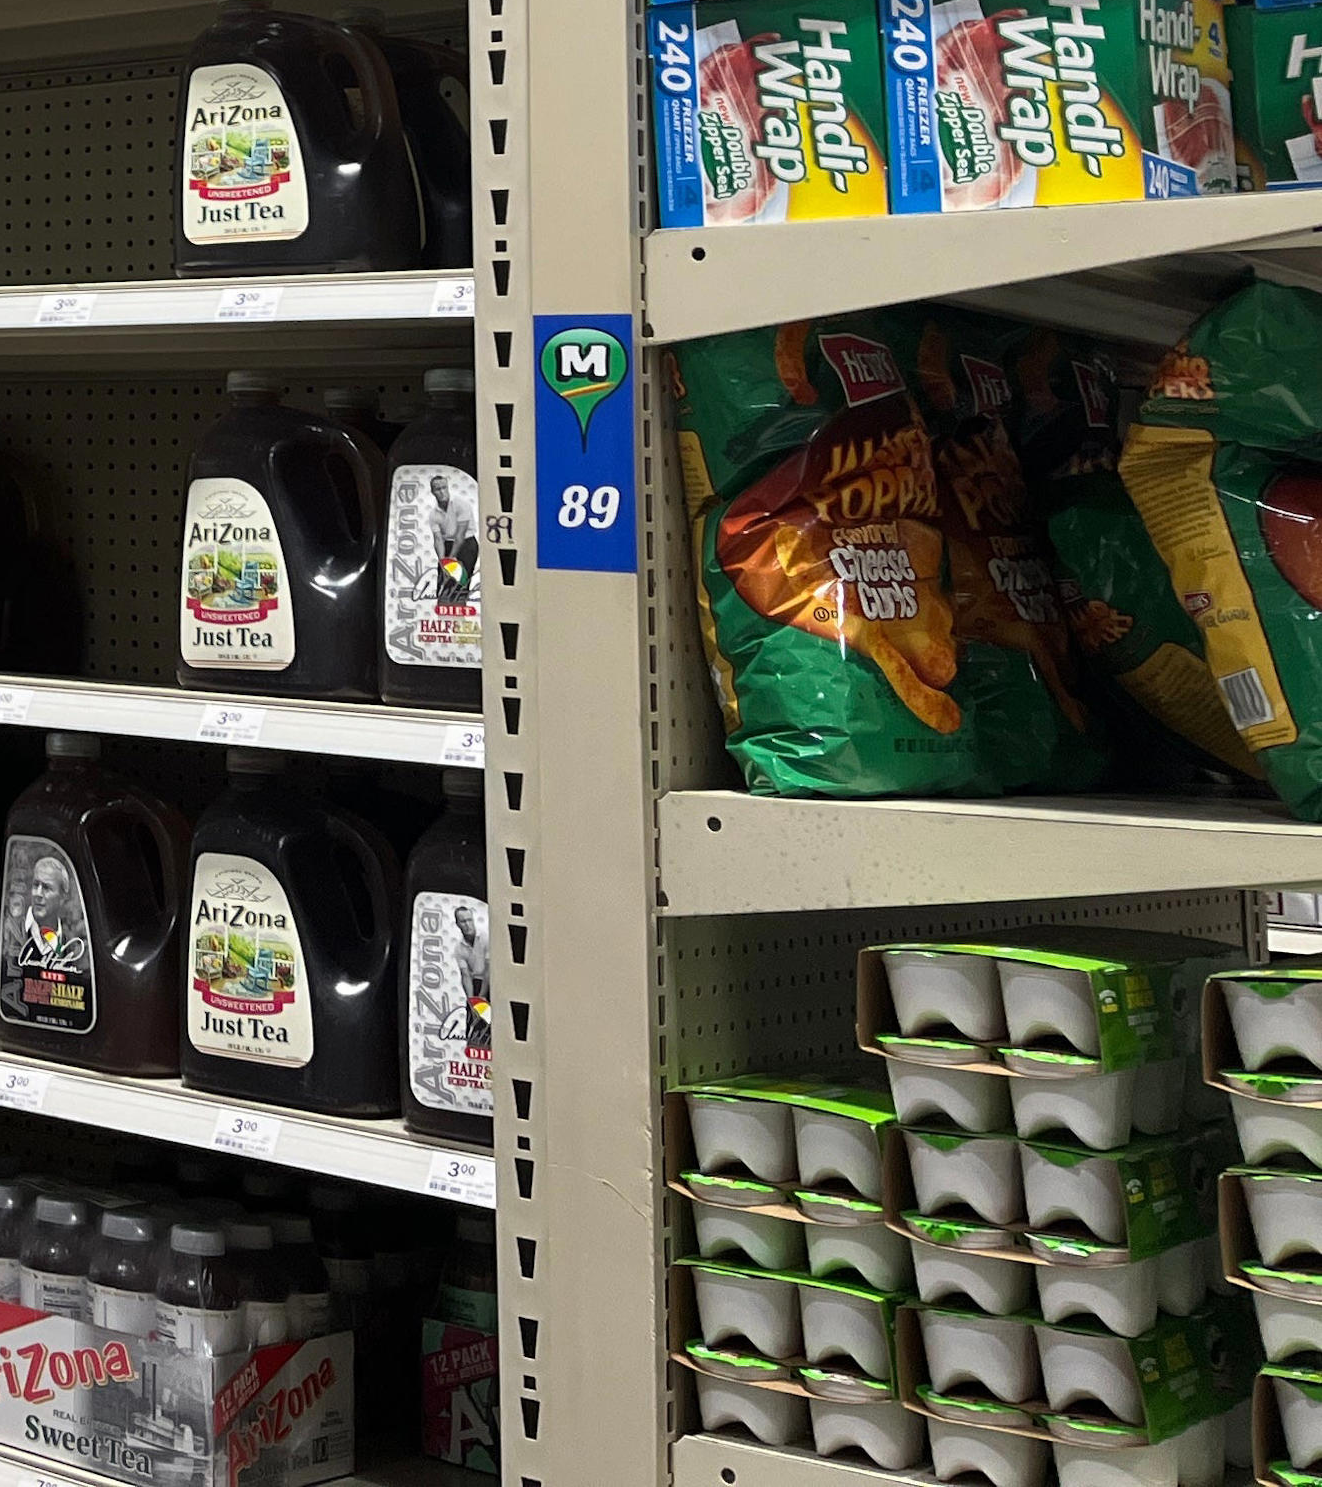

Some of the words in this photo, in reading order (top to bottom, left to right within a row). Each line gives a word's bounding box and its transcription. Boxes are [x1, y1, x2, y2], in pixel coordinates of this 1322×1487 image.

[659, 21, 692, 92] 240
[999, 17, 1056, 166] Wrap
[1149, 44, 1200, 115] Wrap
[191, 104, 282, 132] AriZona
[755, 41, 806, 183] Wrap
[799, 18, 869, 193] Handi-
[917, 77, 931, 145] FREEZER
[682, 98, 695, 163] FREEZER
[936, 91, 965, 148] Zipper
[954, 147, 973, 184] Seal
[961, 106, 995, 174] Double
[698, 112, 725, 164] Zipper
[715, 164, 732, 200] Seal
[721, 126, 751, 190] Double
[198, 203, 241, 225] Just
[246, 202, 284, 222] Tea
[207, 184, 272, 200] UNSWEETENED
[557, 484, 621, 530] 89
[189, 523, 273, 547] AriZona
[486, 515, 513, 544] 89
[831, 521, 899, 547] Flavored
[829, 547, 915, 582] Cheese
[201, 609, 261, 622] UNSWEETENED
[858, 581, 918, 621] Curls
[192, 627, 235, 649] Just
[240, 628, 273, 649] Tea
[195, 899, 289, 930] AriZona
[210, 994, 276, 1013] UNSWEETENED
[201, 1010, 246, 1037] Just
[249, 1019, 290, 1044] Tea
[25, 1414, 98, 1460] Sweet
[98, 1434, 153, 1477] Tea
